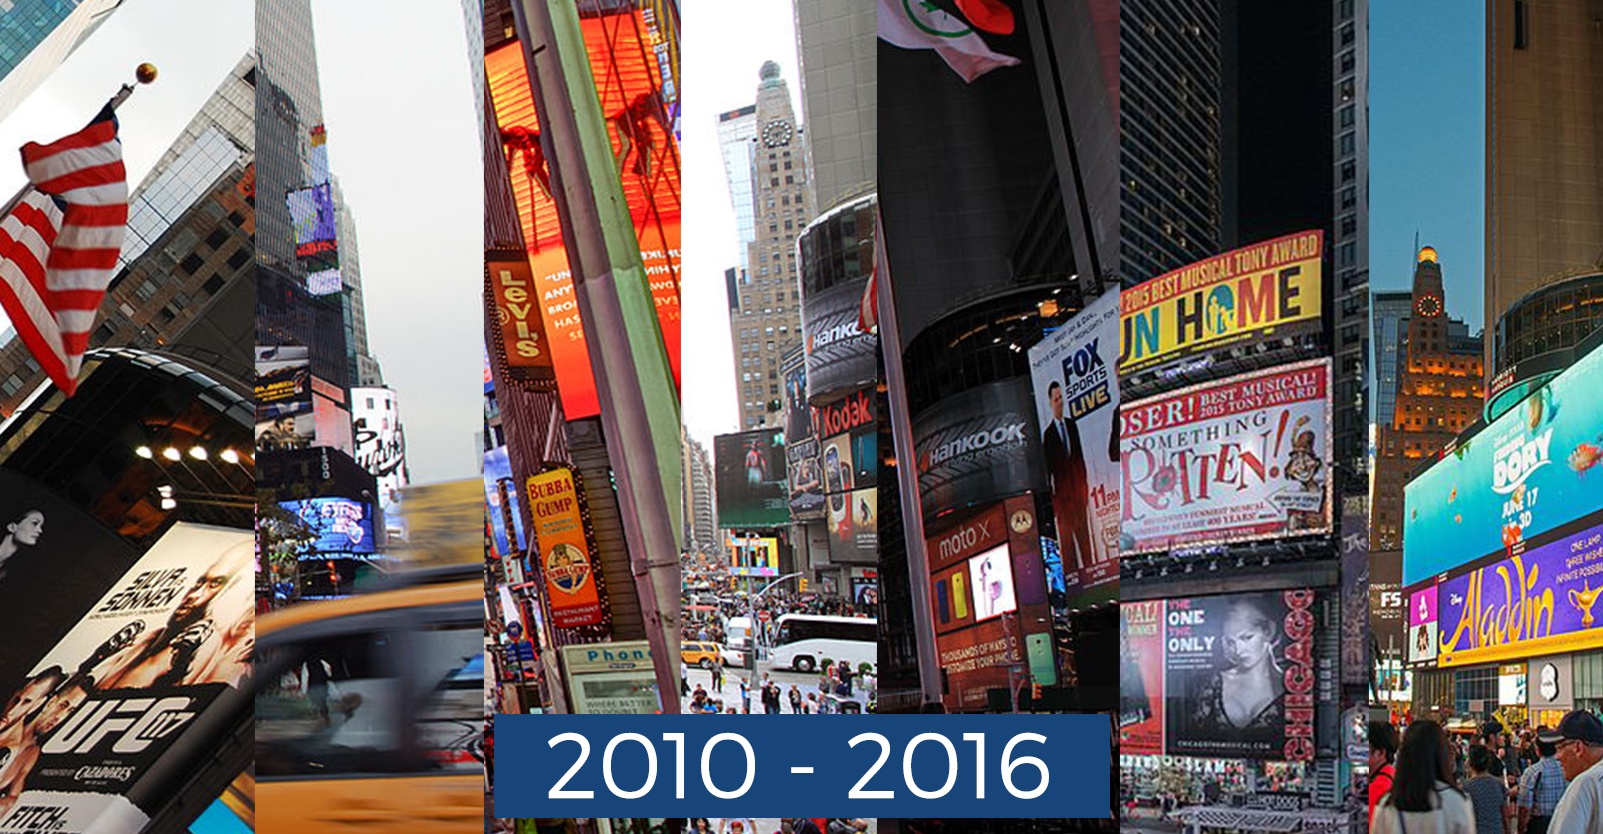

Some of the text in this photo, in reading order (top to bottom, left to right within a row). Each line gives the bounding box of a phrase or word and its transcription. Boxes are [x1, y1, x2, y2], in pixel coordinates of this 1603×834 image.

[1125, 234, 1318, 312] 2015 BEST MUSICAL TONY AWARD
[1176, 264, 1302, 344] HOME
[1062, 336, 1104, 387] FOX
[1066, 366, 1107, 399] SPORTS
[1200, 372, 1317, 406] BEST MUSICAL!
[823, 390, 873, 437] Kodak
[1071, 385, 1108, 417] LIVE
[1200, 386, 1317, 418] 2015 TONY AWARD
[1131, 410, 1267, 451] SOMETHING
[1493, 427, 1554, 488] DORY
[529, 477, 572, 500] BUBBA
[1091, 483, 1106, 509] 11
[1527, 487, 1539, 507] 17
[536, 497, 573, 518] GUMP
[939, 524, 977, 560] moto
[125, 567, 187, 591] SILVA
[98, 586, 184, 612] SONNEN
[1439, 555, 1554, 654] Aladdin
[1168, 610, 1205, 625] ONE
[1168, 636, 1215, 653] ONLY
[1284, 590, 1315, 761] CHICAGO
[41, 697, 196, 753] UFC 117
[1, 806, 70, 829] FITCH
